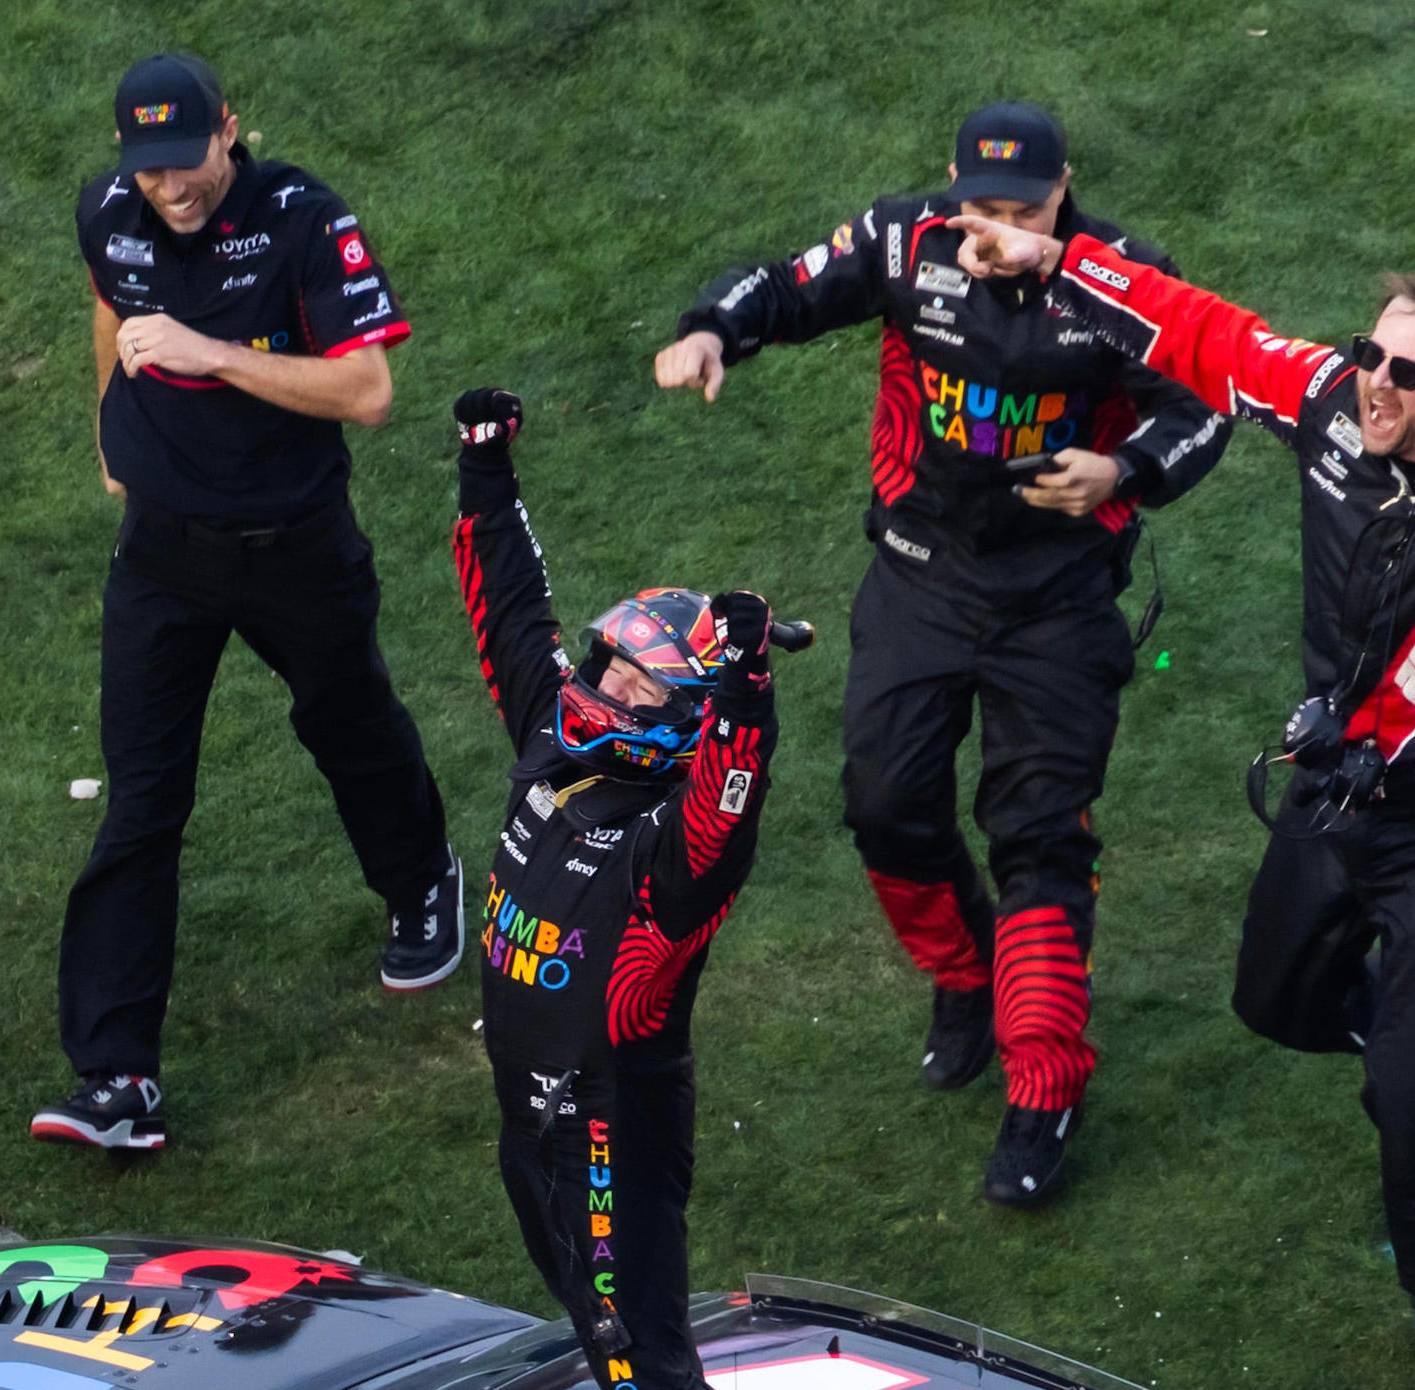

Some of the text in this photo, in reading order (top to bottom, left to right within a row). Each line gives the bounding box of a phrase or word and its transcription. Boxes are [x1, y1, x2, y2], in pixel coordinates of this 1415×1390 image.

[1078, 258, 1130, 292] sparco
[920, 360, 1086, 425] CHUMBA
[1305, 352, 1344, 399] sparco
[929, 402, 1077, 460] CASINO
[481, 905, 571, 990] ASINO
[529, 1095, 577, 1114] spco
[588, 1118, 615, 1262] CHUMBA
